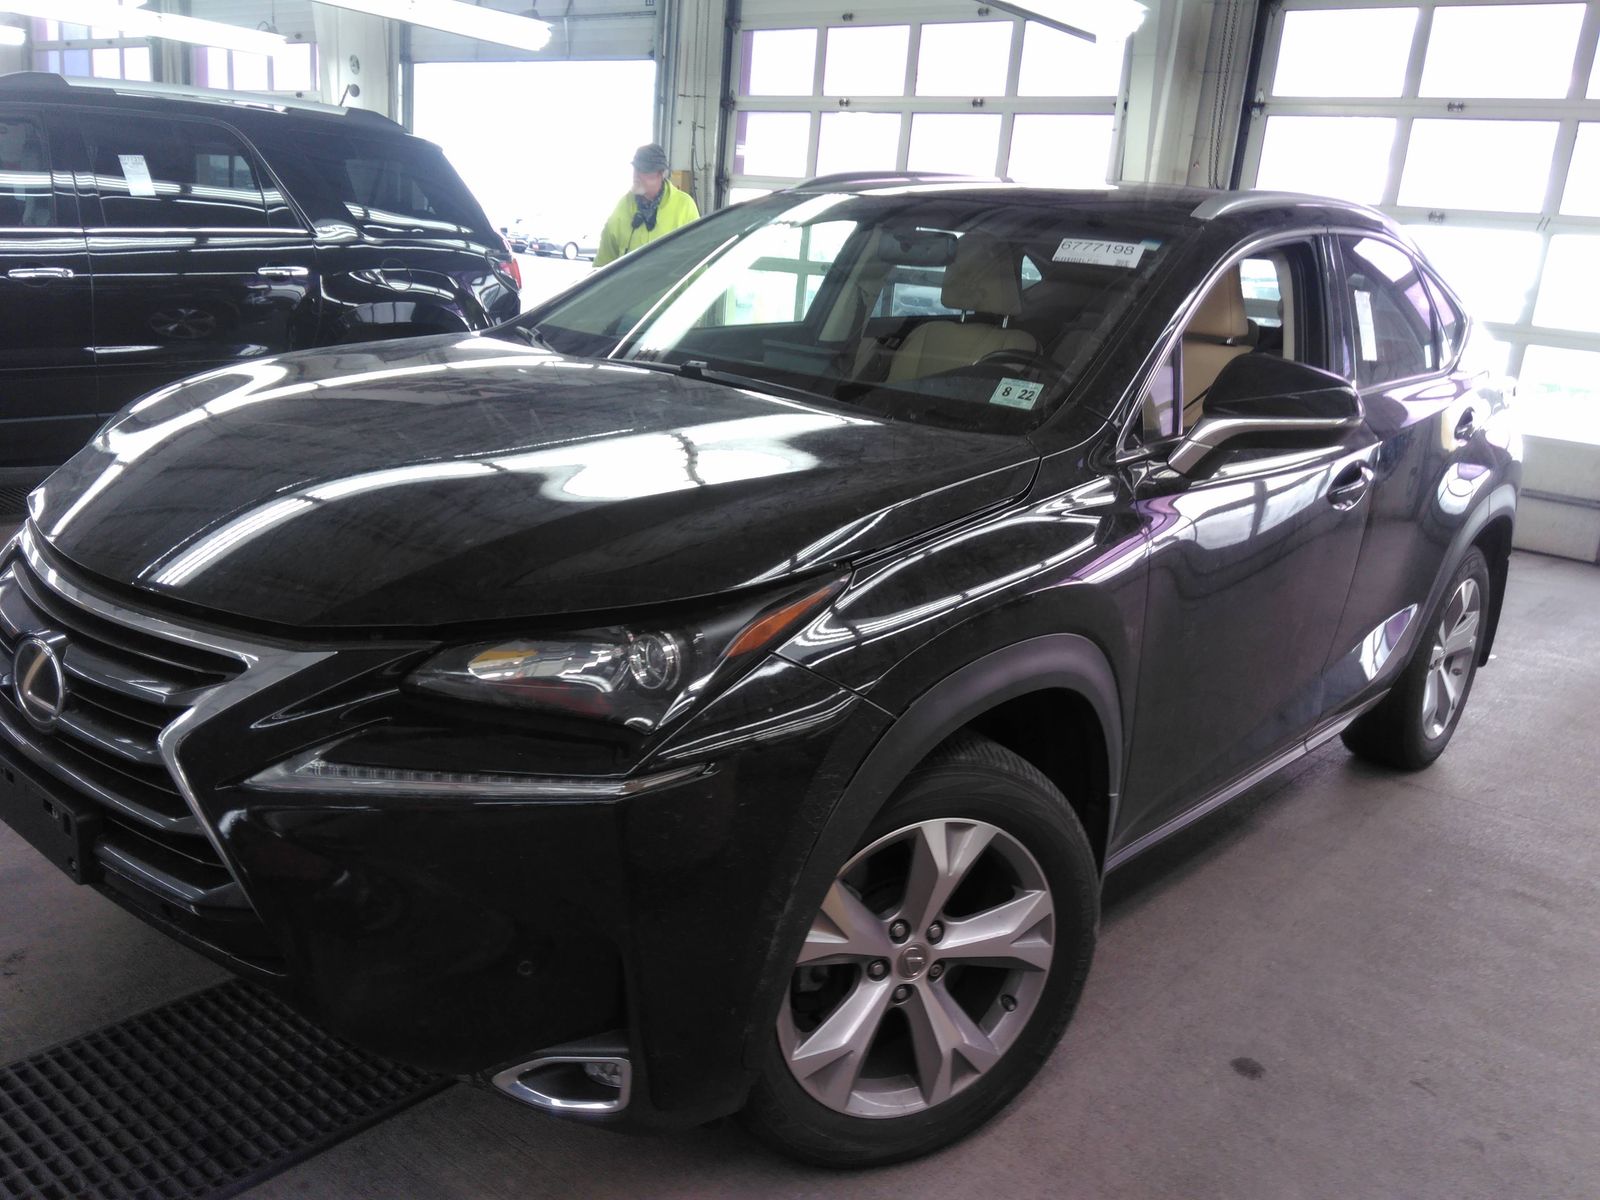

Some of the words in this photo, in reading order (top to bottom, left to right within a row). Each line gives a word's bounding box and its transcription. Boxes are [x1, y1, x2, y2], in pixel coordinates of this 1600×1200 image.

[1060, 240, 1135, 255] 6777198
[1002, 386, 1013, 397] 8
[1017, 389, 1035, 401] 22
